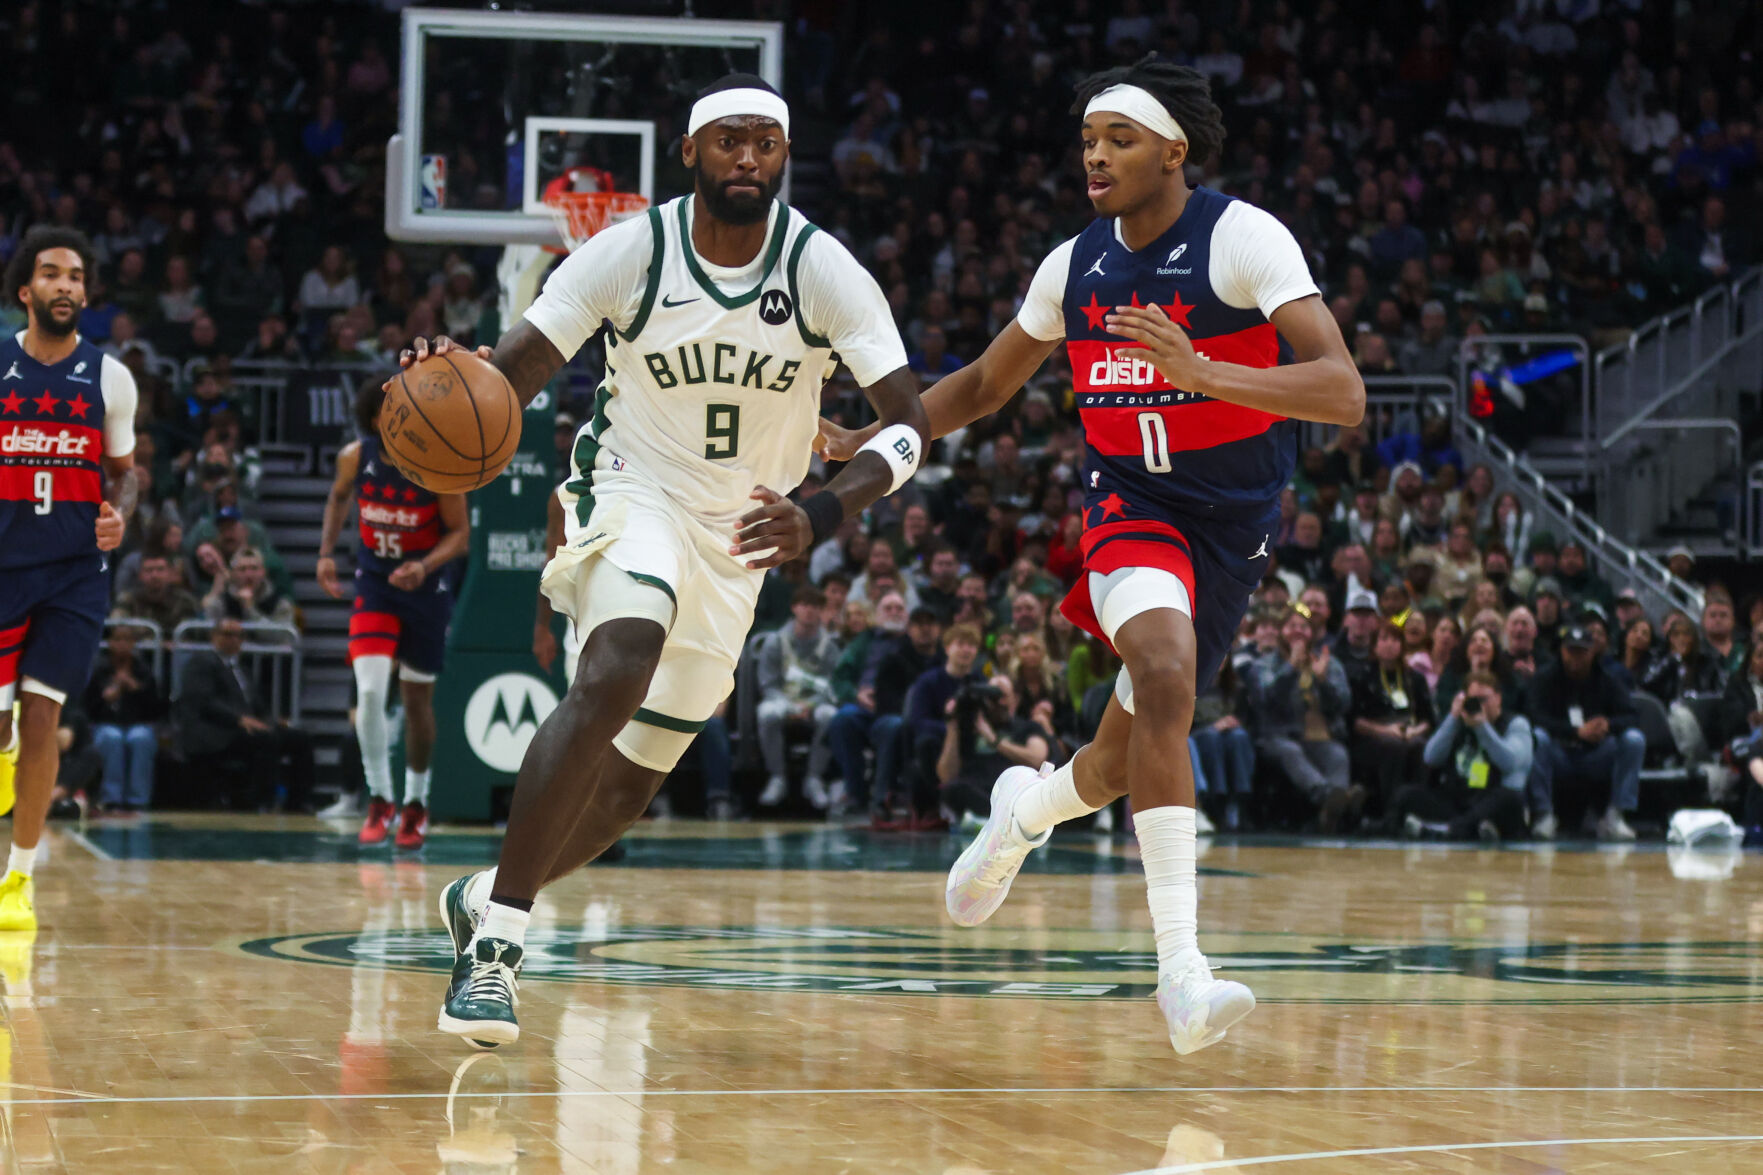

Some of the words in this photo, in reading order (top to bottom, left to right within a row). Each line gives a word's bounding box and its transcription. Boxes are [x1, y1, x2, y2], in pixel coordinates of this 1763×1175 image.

[1156, 267, 1192, 275] Robinhood
[644, 342, 802, 393] BUCKS
[1086, 396, 1105, 404] OF
[1, 425, 91, 455] district
[705, 403, 740, 459] 9
[1137, 411, 1173, 474] 0
[893, 437, 914, 465] BP
[34, 471, 52, 515] 9
[373, 531, 402, 559] 35
